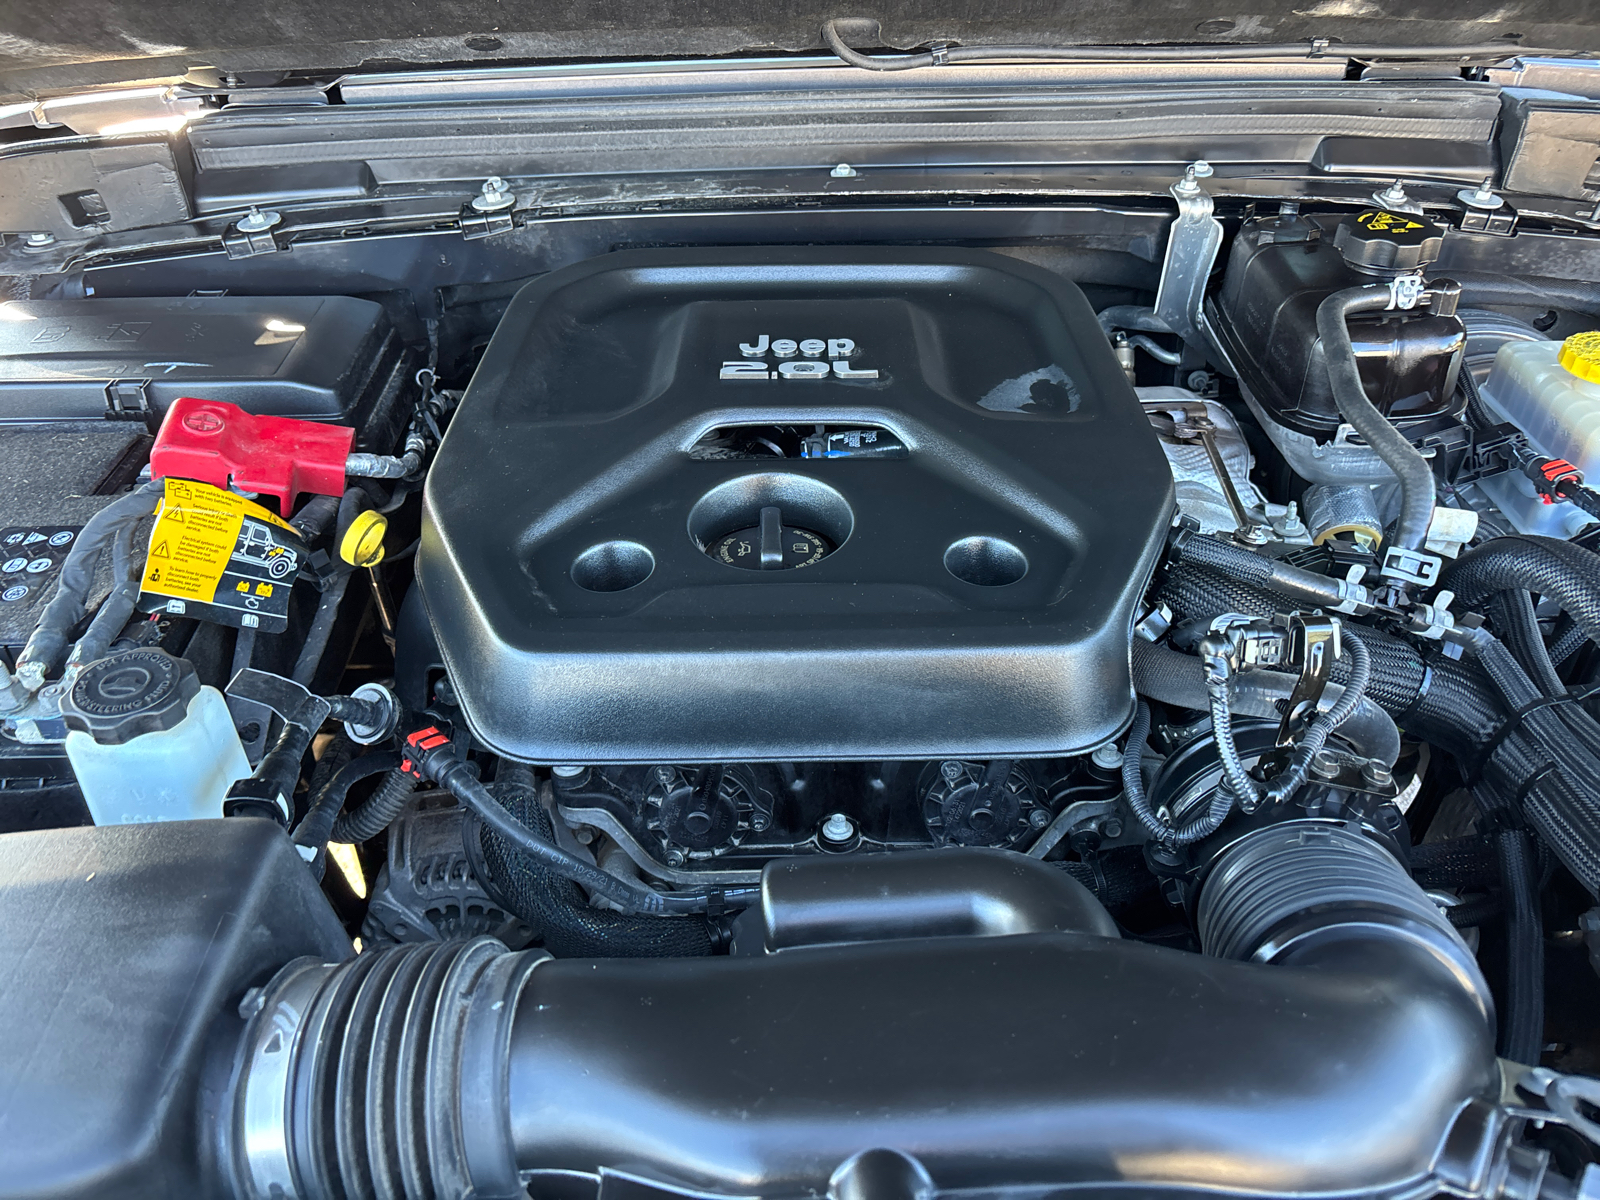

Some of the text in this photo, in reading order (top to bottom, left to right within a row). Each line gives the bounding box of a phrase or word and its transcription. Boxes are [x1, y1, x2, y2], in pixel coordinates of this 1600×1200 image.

[739, 334, 855, 360] Jeep
[719, 361, 879, 380] 2.0L
[192, 503, 208, 511] Serious
[190, 514, 207, 522] batteries
[188, 520, 215, 530] disconnected
[182, 535, 201, 543] Electrical
[177, 545, 196, 553] batteries
[186, 542, 205, 550] damaged
[720, 537, 737, 563] ENGINE OIL
[175, 551, 203, 561] disconnected
[167, 571, 190, 579] disconnect
[199, 573, 217, 581] properly
[164, 582, 186, 591] authorized
[96, 652, 173, 671] USE APPROVED
[86, 700, 143, 713] STEERING
[144, 680, 171, 702] FLUID
[526, 839, 546, 855] DOT
[573, 863, 609, 886] 10/29/21
